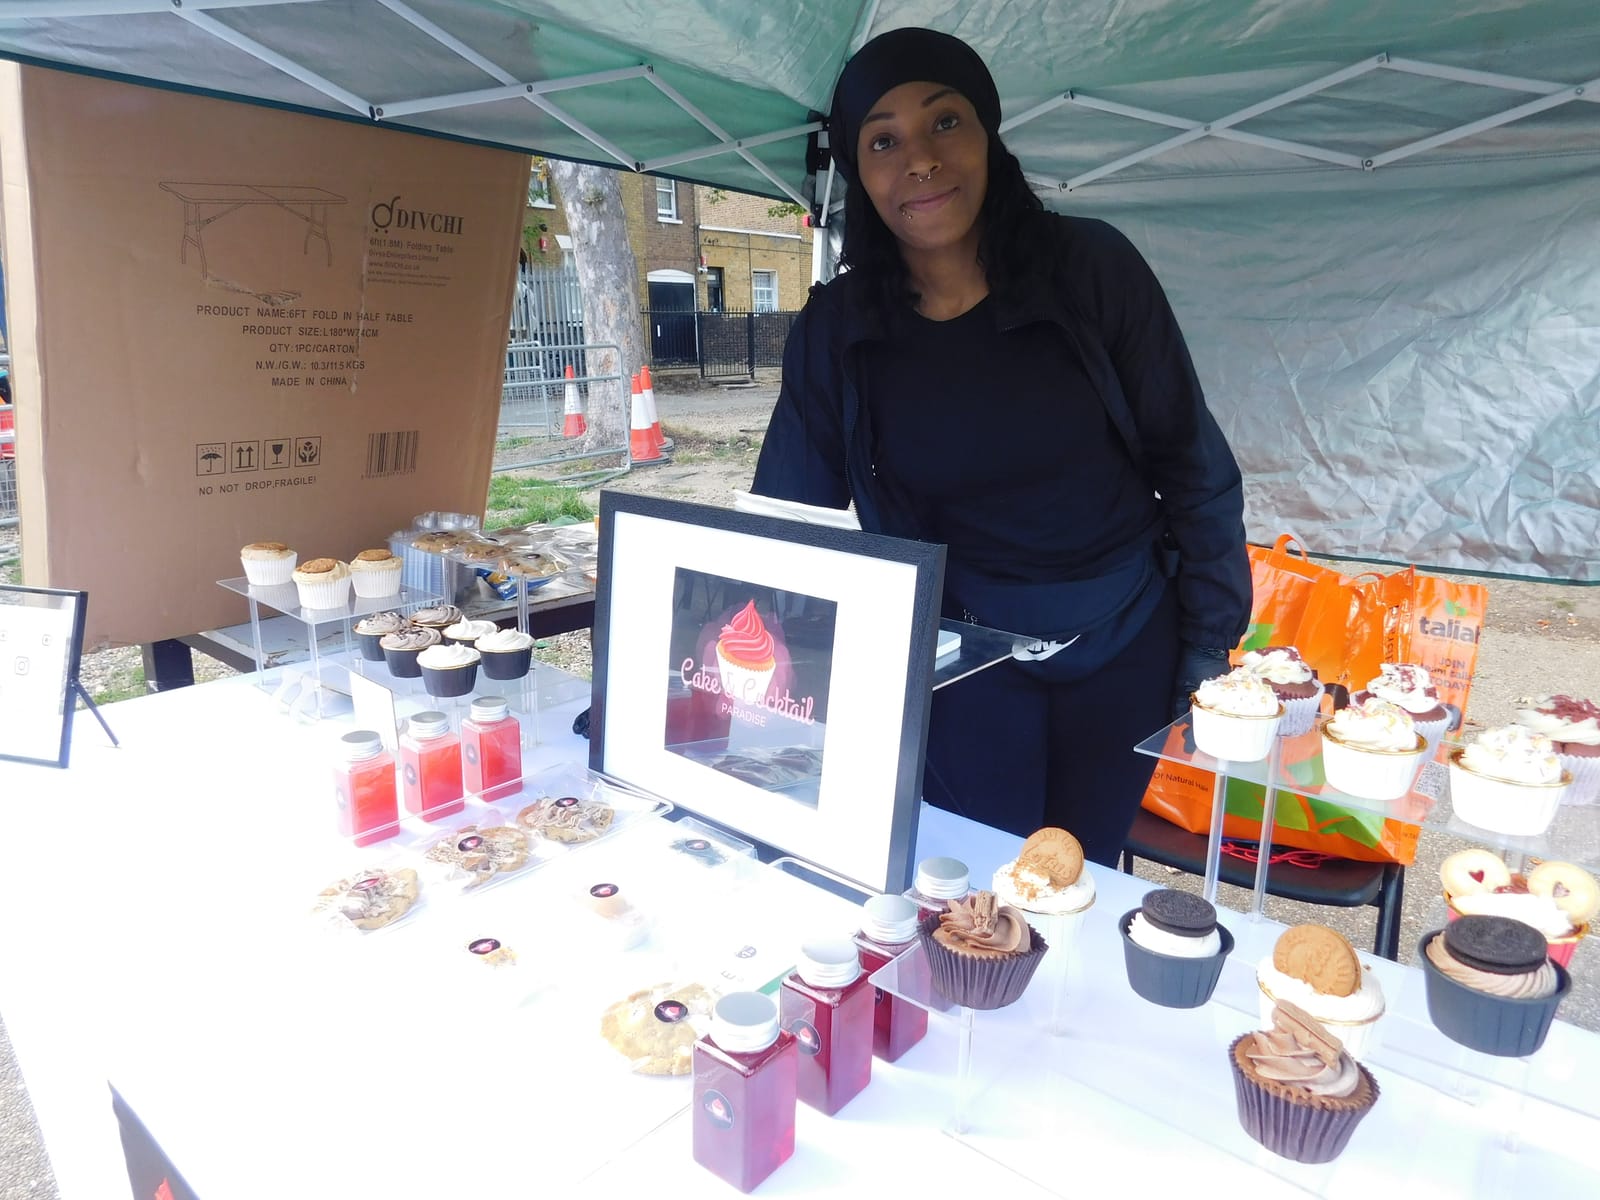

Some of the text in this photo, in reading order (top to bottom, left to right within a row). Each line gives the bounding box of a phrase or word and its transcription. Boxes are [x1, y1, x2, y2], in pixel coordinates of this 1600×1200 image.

[396, 208, 464, 235] DIVCHI
[196, 305, 413, 323] PRODUCT NAME:6FT FOLD IN HALF TABLE
[242, 325, 292, 336] PRODUCT
[271, 376, 347, 387] MADE IN CHINA
[199, 487, 213, 496] NO
[219, 483, 240, 495] NOT
[1439, 657, 1466, 669] JOIN
[680, 657, 722, 695] Cake
[743, 678, 815, 726] Cocktail
[721, 702, 767, 728] PARADISE
[1165, 773, 1195, 787] Natural
